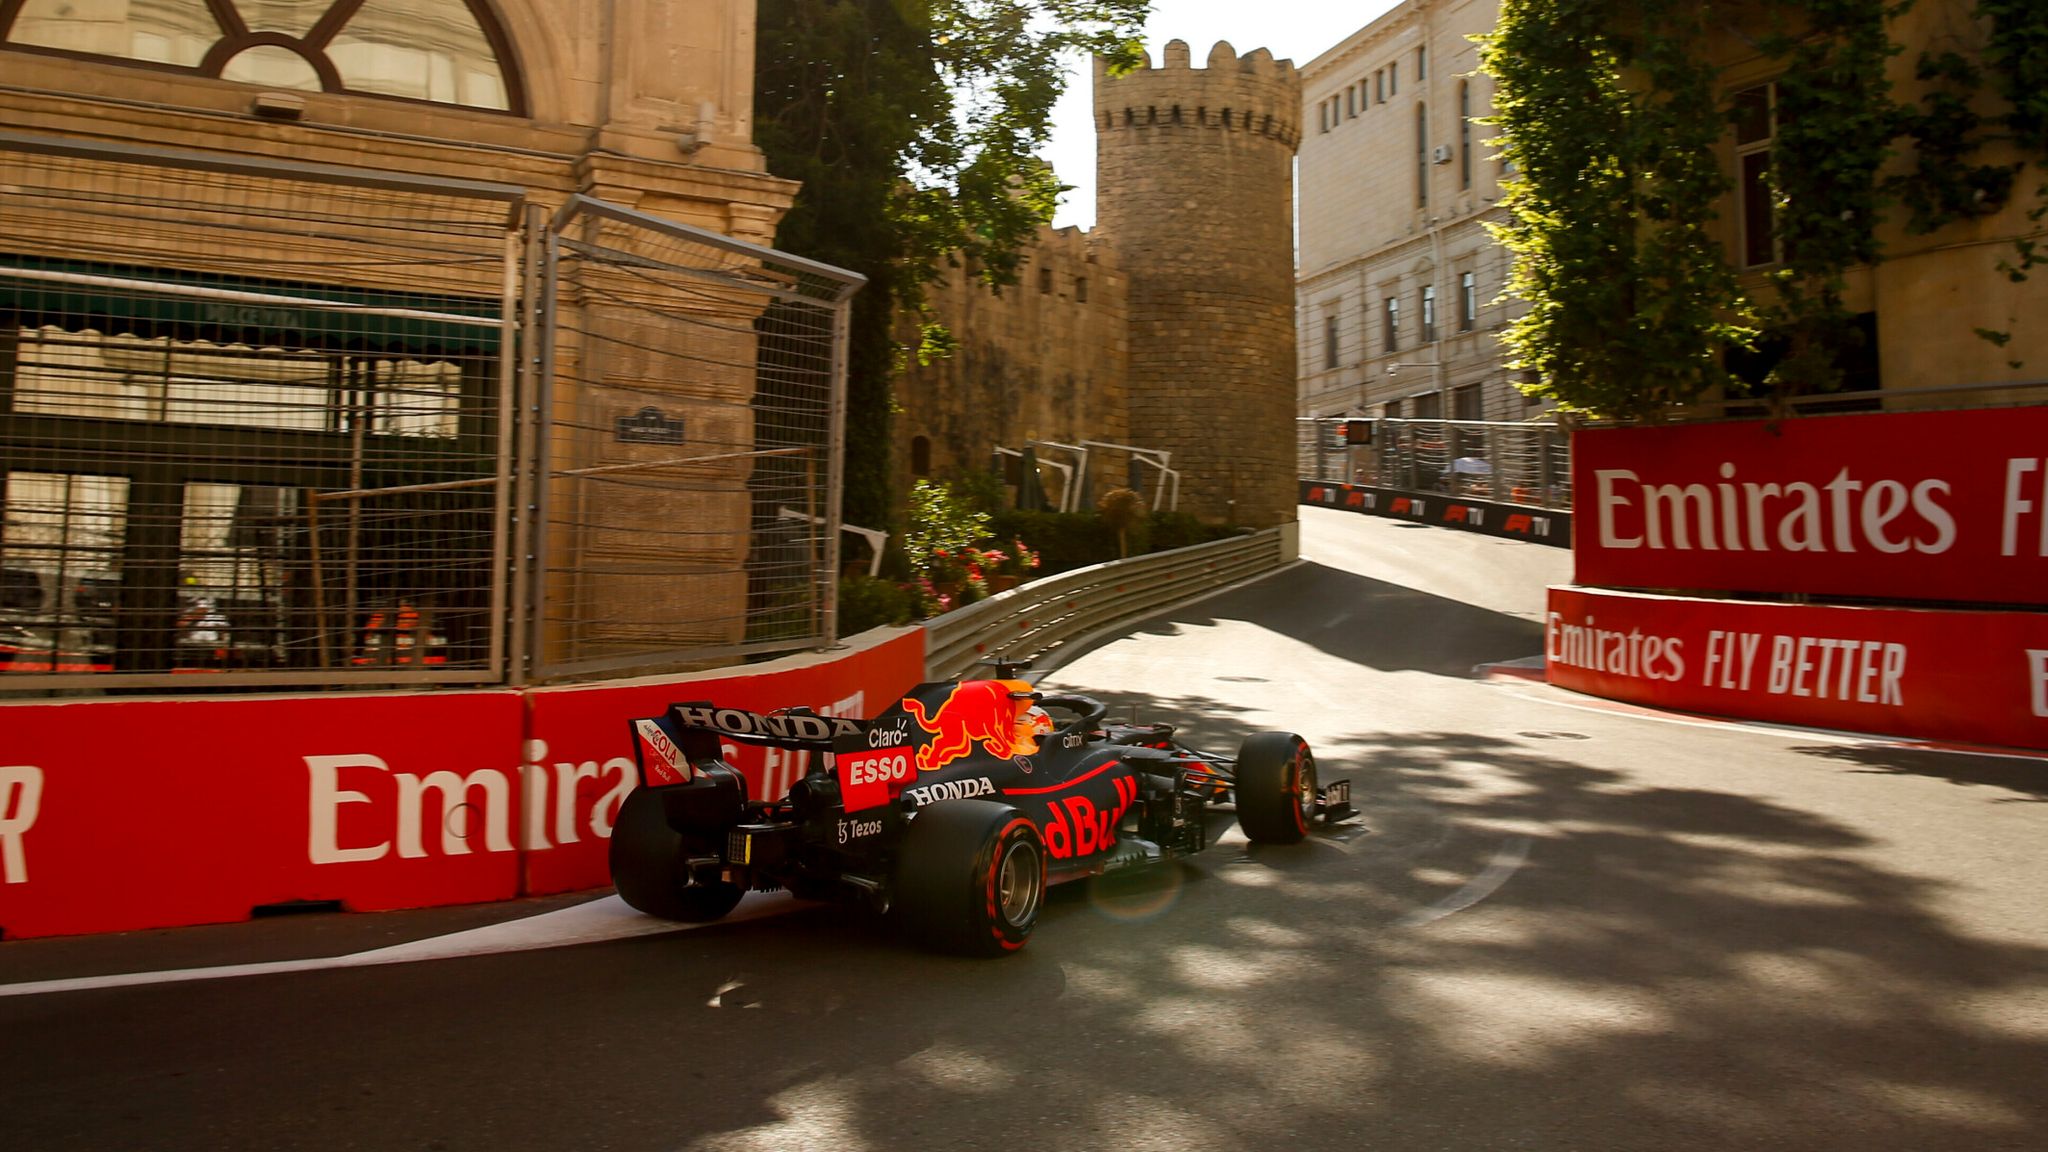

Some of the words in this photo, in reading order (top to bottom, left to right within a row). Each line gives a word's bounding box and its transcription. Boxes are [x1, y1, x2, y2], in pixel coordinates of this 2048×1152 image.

[1594, 461, 1957, 556] Emirates
[1548, 610, 1686, 683] Emirates
[1703, 630, 1761, 691] FLY
[1767, 635, 1907, 706] BETTER
[675, 706, 864, 741] HONDA
[869, 726, 904, 748] Claro
[652, 730, 677, 766] COLA
[850, 755, 907, 786] ESSO
[303, 738, 738, 864] Emira
[906, 776, 996, 807] HONDA
[850, 819, 882, 839] Tezos
